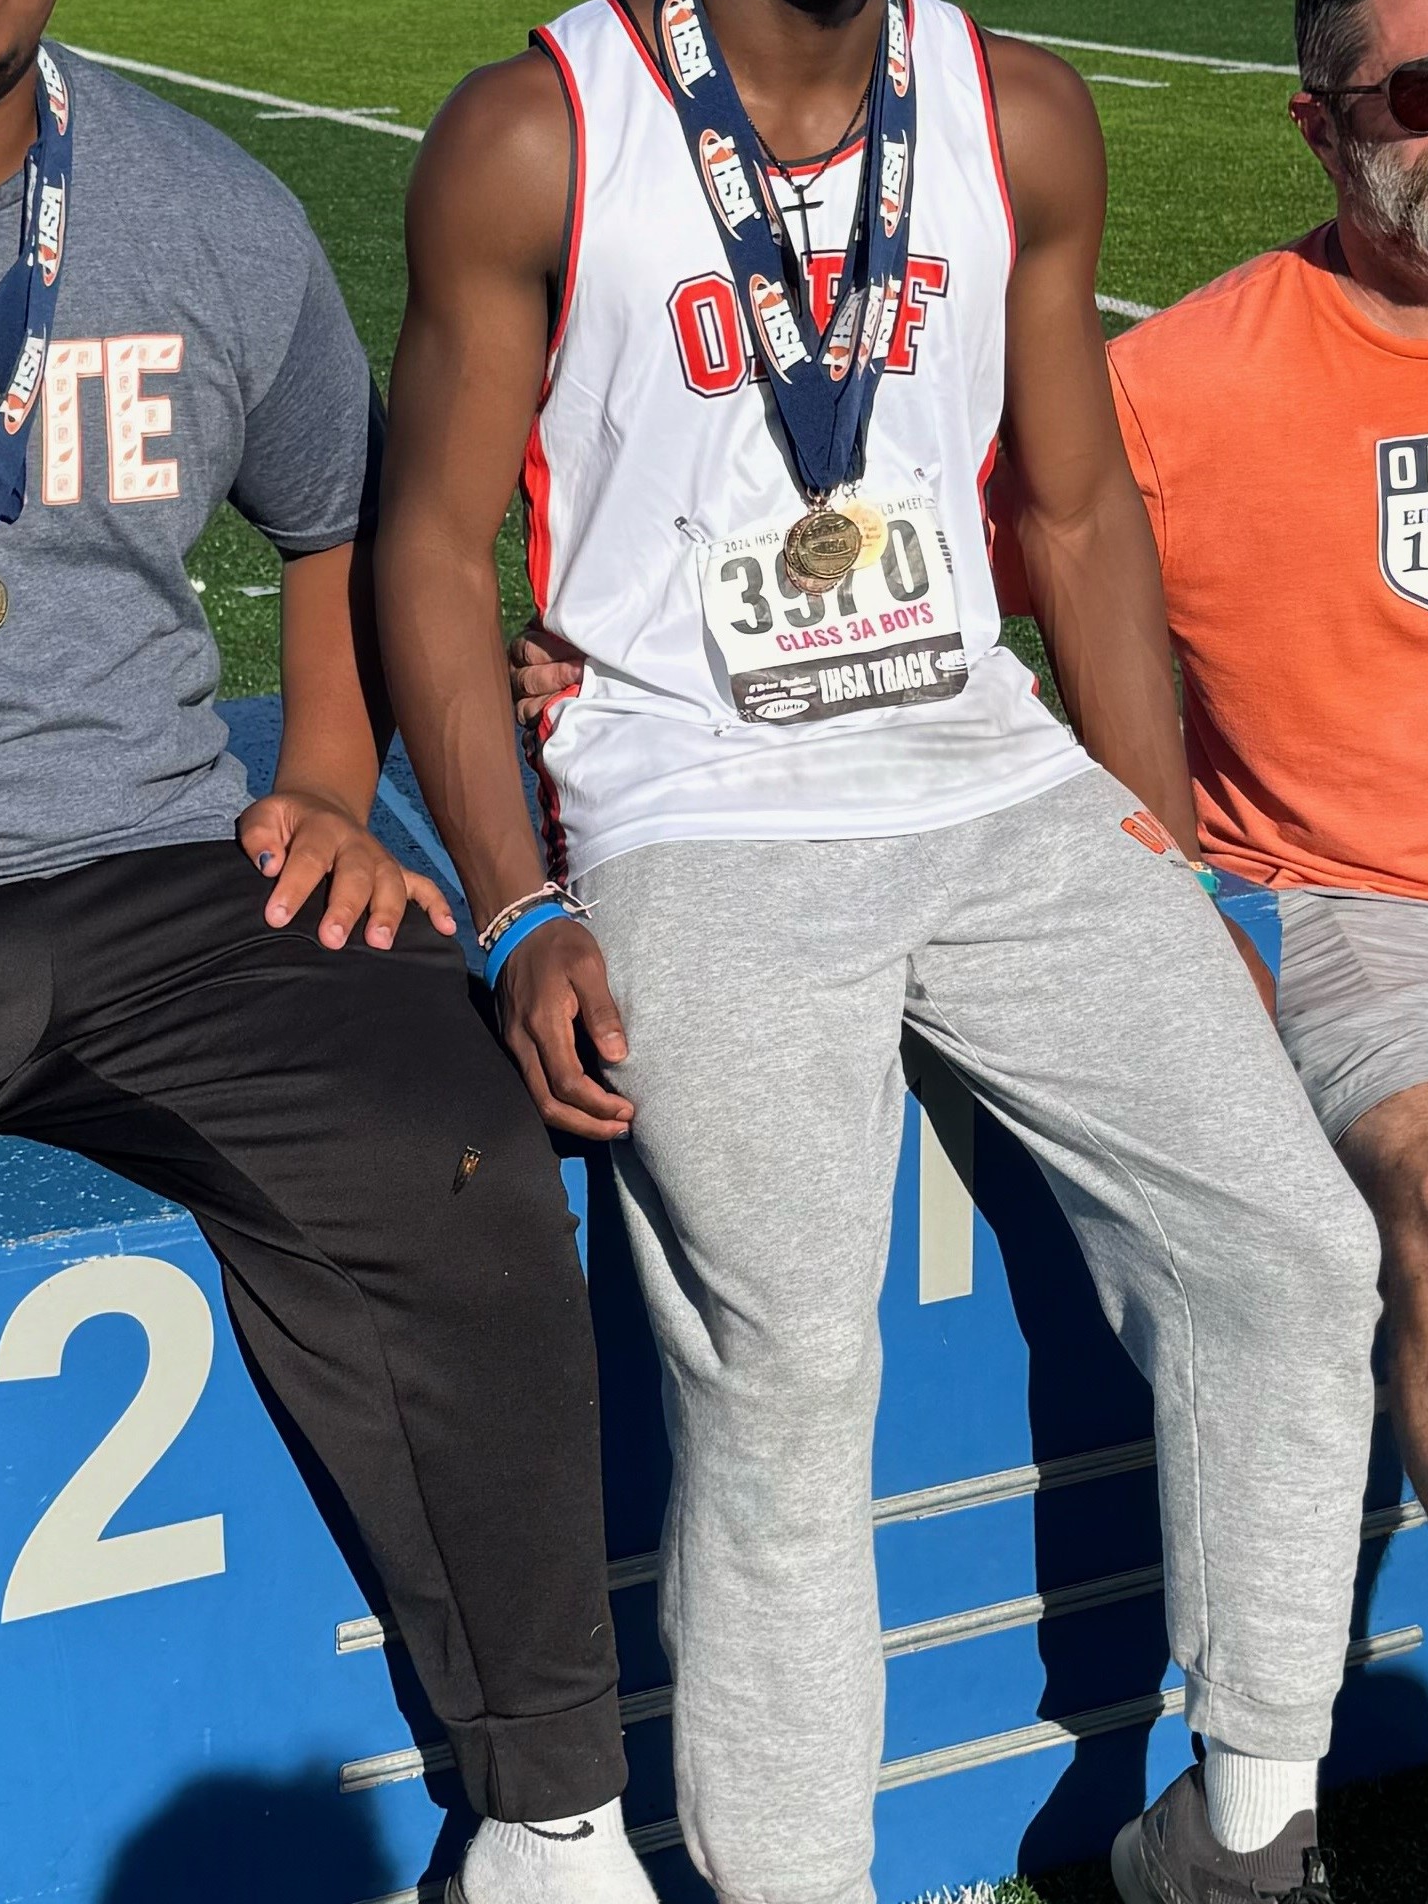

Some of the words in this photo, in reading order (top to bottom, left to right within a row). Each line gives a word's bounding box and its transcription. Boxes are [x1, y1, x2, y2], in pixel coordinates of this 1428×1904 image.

[776, 626, 843, 652] CLASS
[846, 618, 877, 642] 3A
[879, 602, 935, 635] BOYS
[818, 663, 871, 704] IHSA
[869, 650, 938, 695] TRACK
